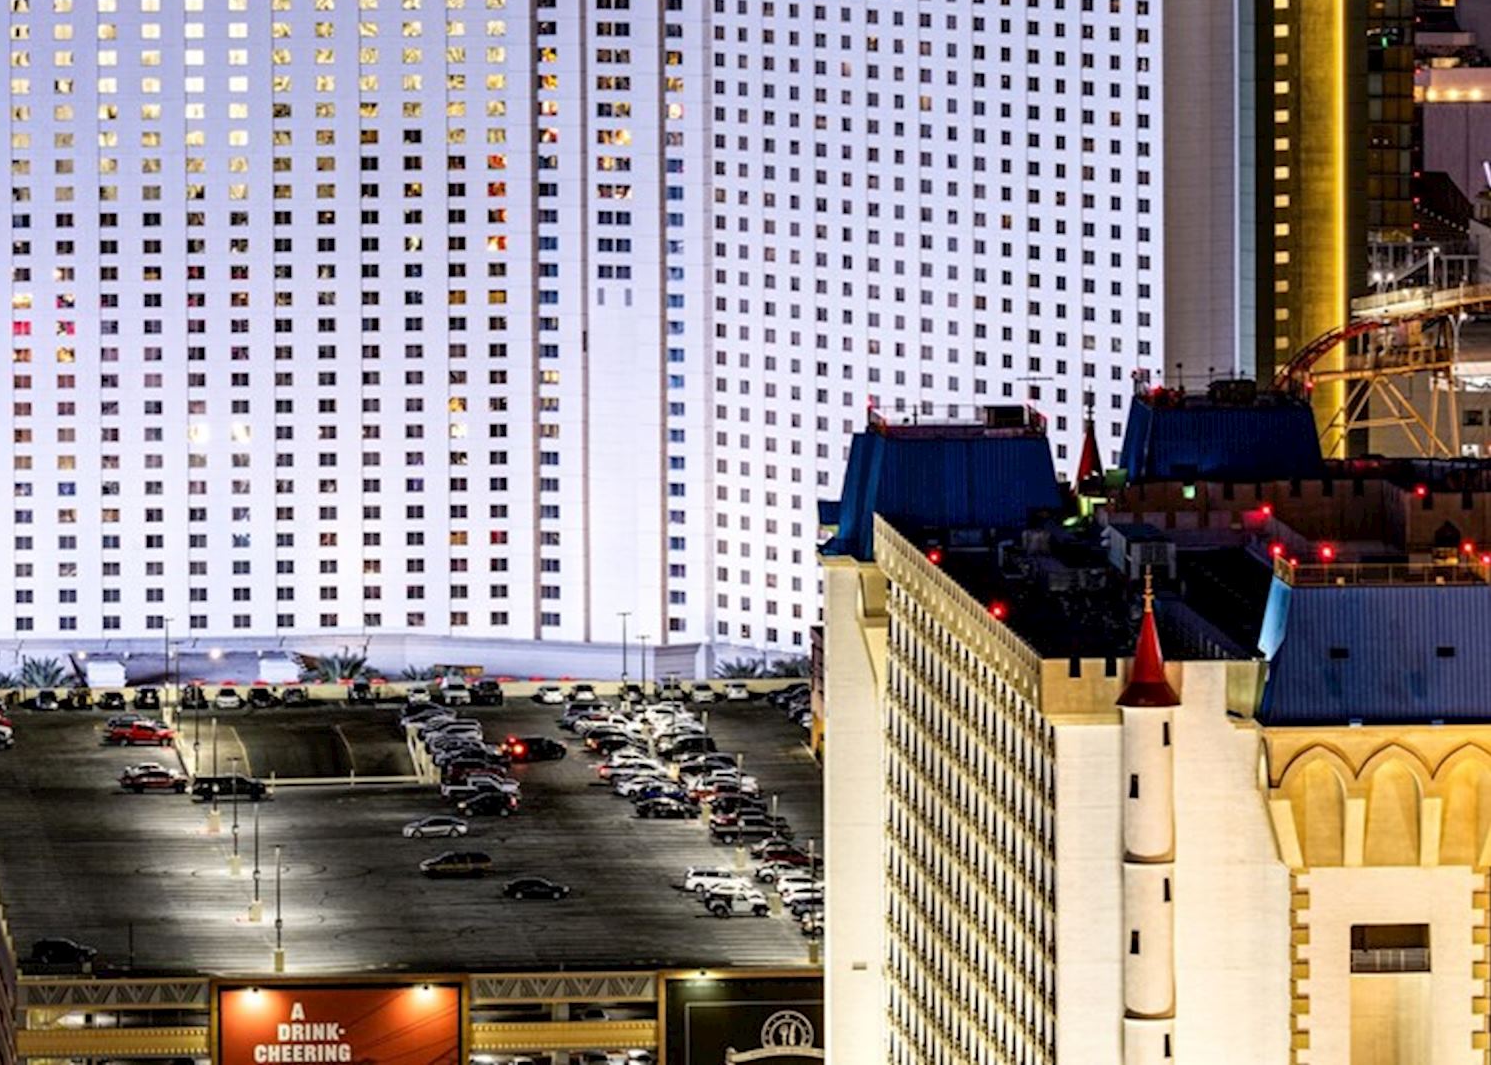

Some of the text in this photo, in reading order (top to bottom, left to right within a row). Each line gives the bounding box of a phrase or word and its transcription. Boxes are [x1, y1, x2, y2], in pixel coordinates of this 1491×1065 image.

[290, 1002, 306, 1021] A
[277, 1023, 346, 1041] DRINK-
[254, 1044, 352, 1062] CHEERING
